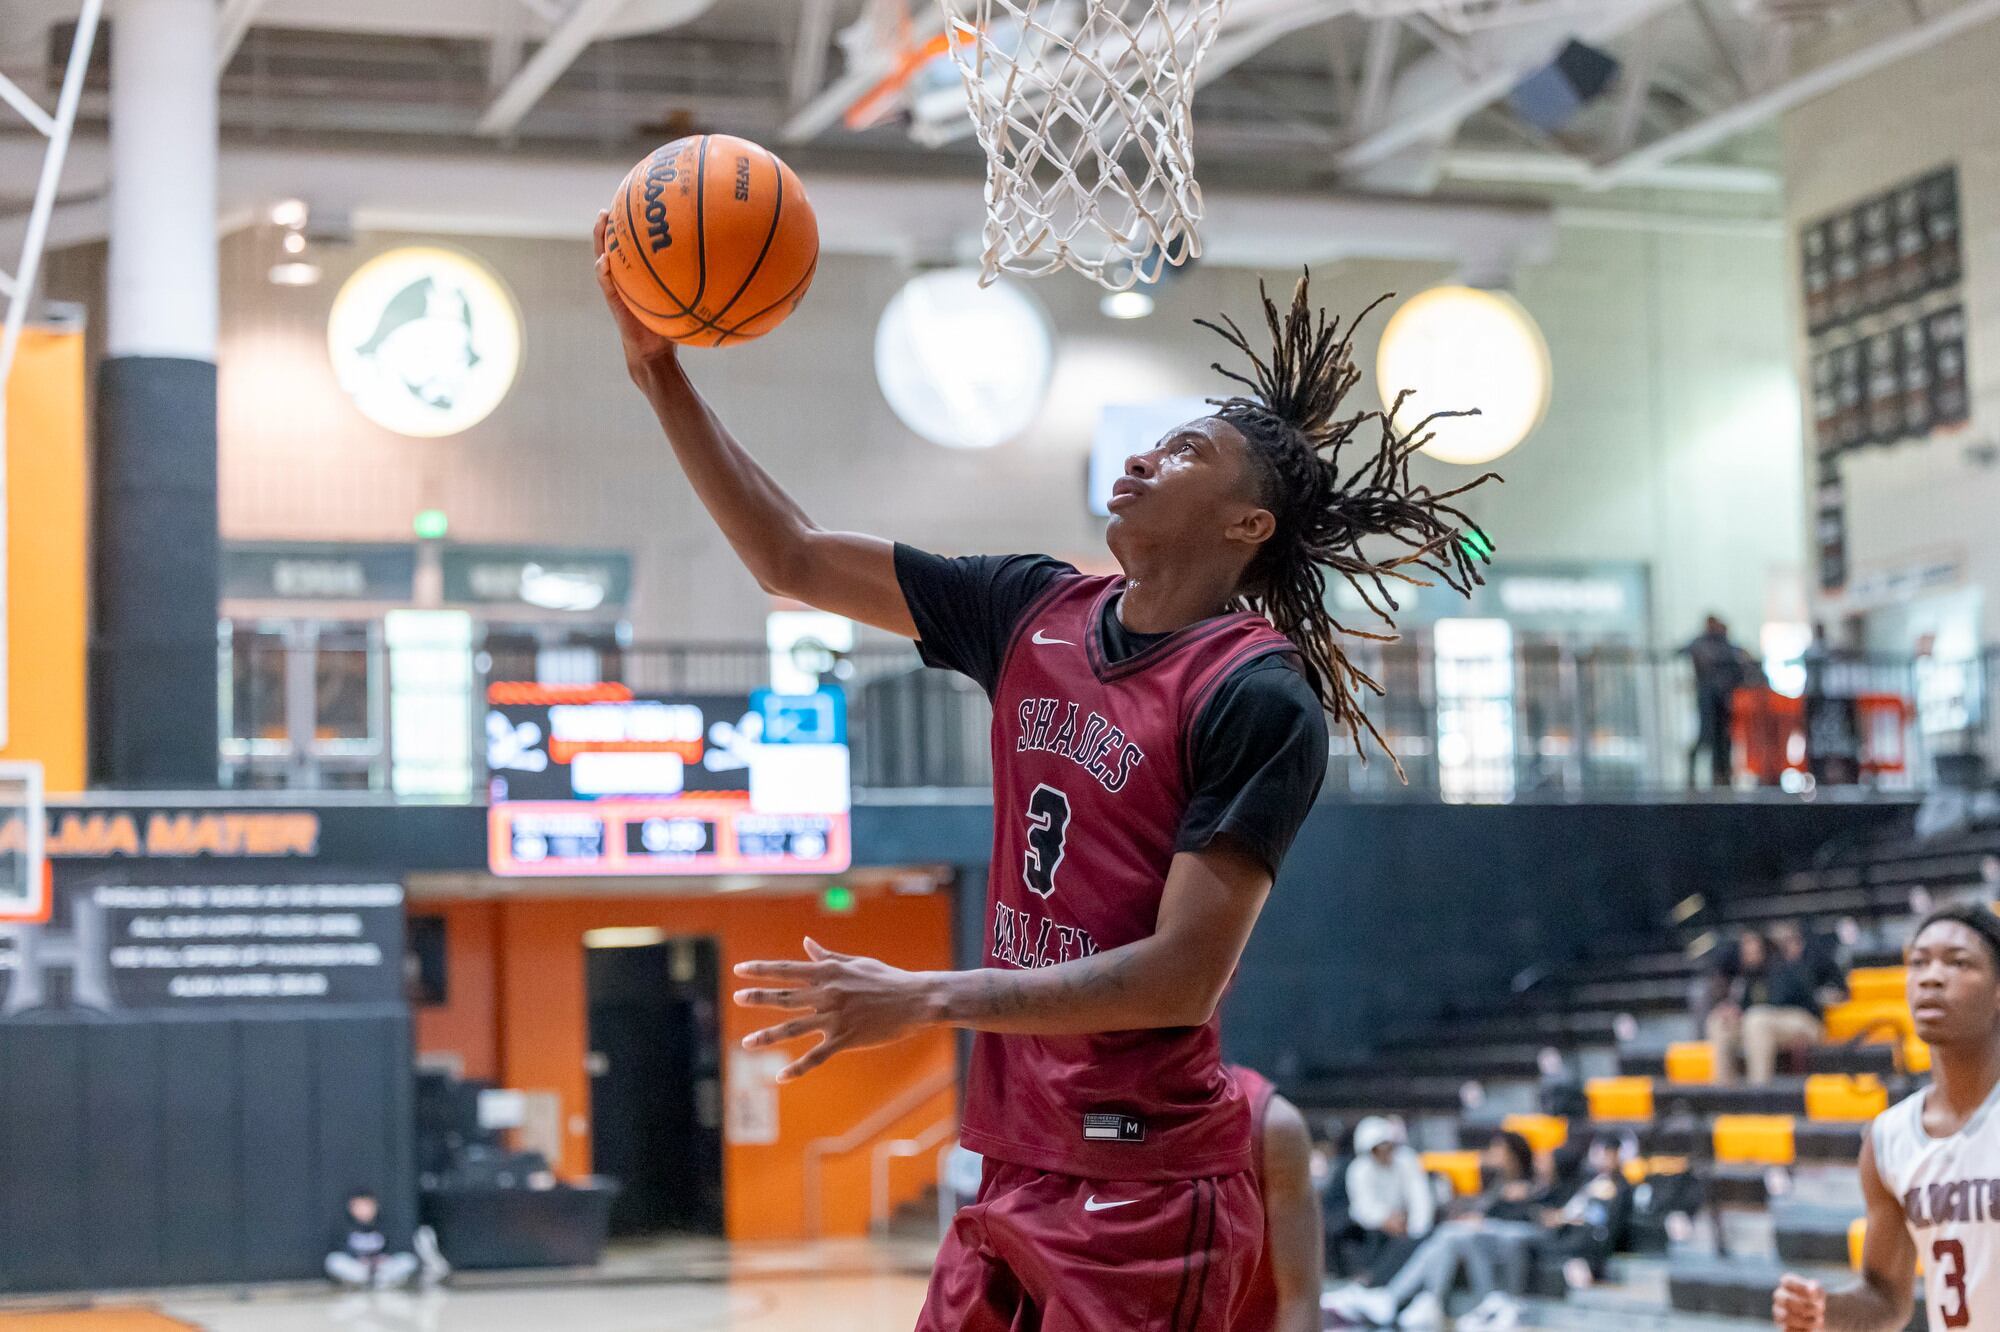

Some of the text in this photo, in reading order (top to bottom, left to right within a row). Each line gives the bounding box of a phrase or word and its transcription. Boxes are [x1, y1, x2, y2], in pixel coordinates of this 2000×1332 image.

[1016, 698, 1145, 793] SHADES
[1023, 782, 1072, 900] 3
[1126, 1121, 1139, 1134] M
[1932, 1239, 1970, 1329] 3
